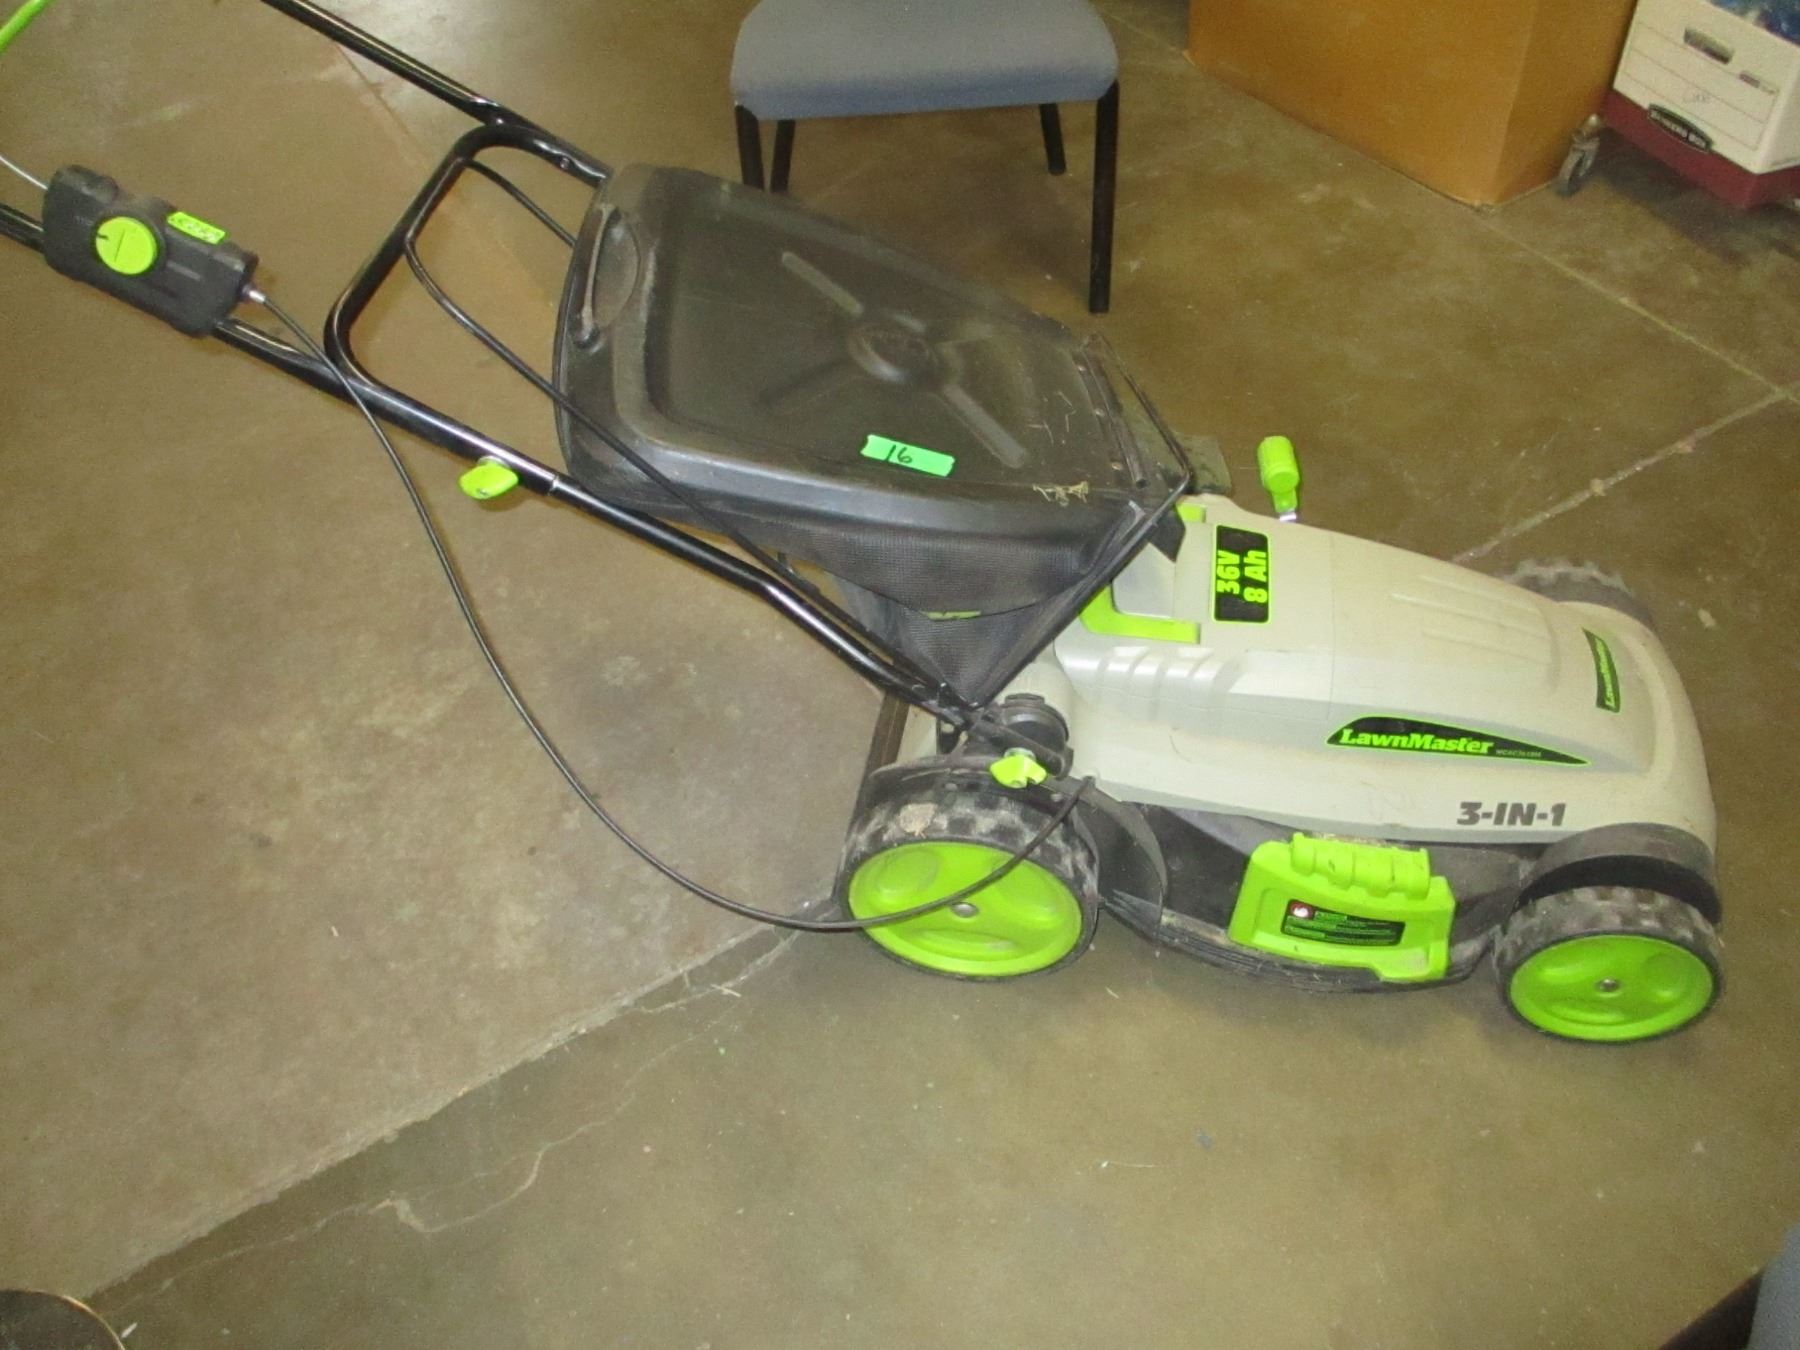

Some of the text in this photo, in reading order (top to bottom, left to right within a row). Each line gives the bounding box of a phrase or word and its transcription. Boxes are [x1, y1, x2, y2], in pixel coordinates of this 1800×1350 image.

[885, 444, 913, 464] 16
[1216, 549, 1240, 595] 36V
[1243, 549, 1268, 603] 8 Ah
[1339, 728, 1494, 755] LawnMaster
[1457, 801, 1566, 827] 3-IN-1
